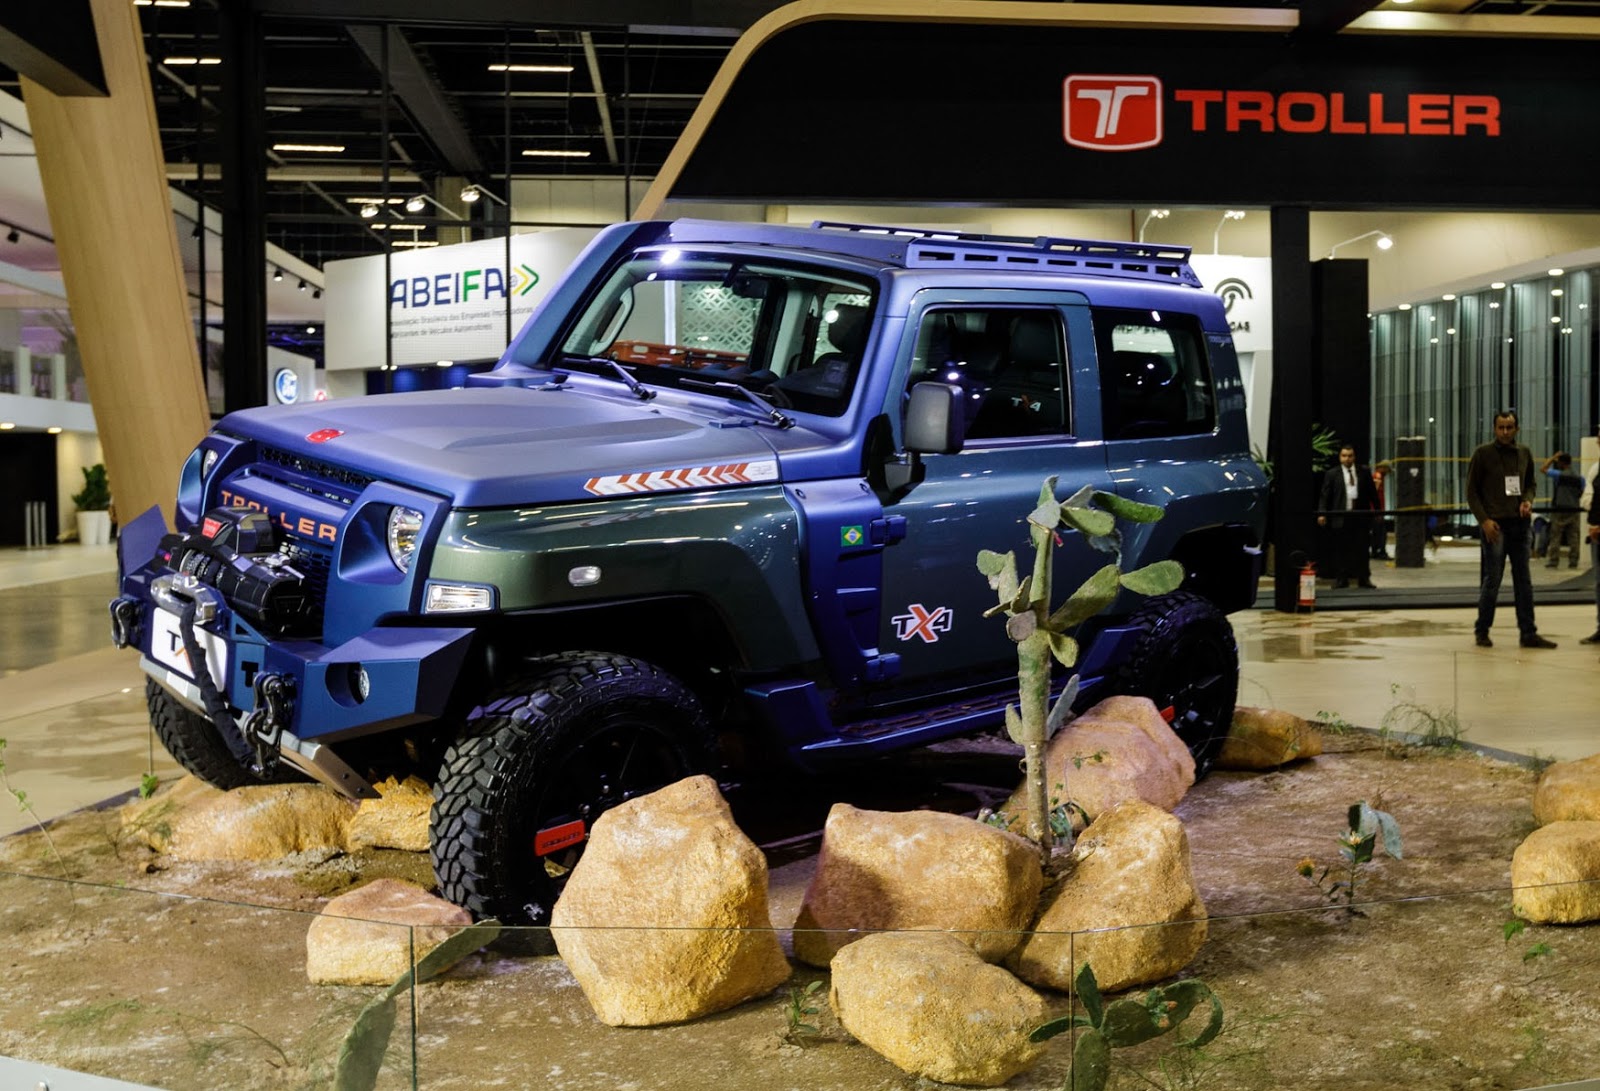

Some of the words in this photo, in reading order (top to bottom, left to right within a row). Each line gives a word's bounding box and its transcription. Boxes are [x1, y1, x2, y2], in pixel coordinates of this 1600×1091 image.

[1174, 89, 1501, 136] TROLLER
[390, 267, 507, 309] ABEIFA
[891, 603, 953, 643] TX4
